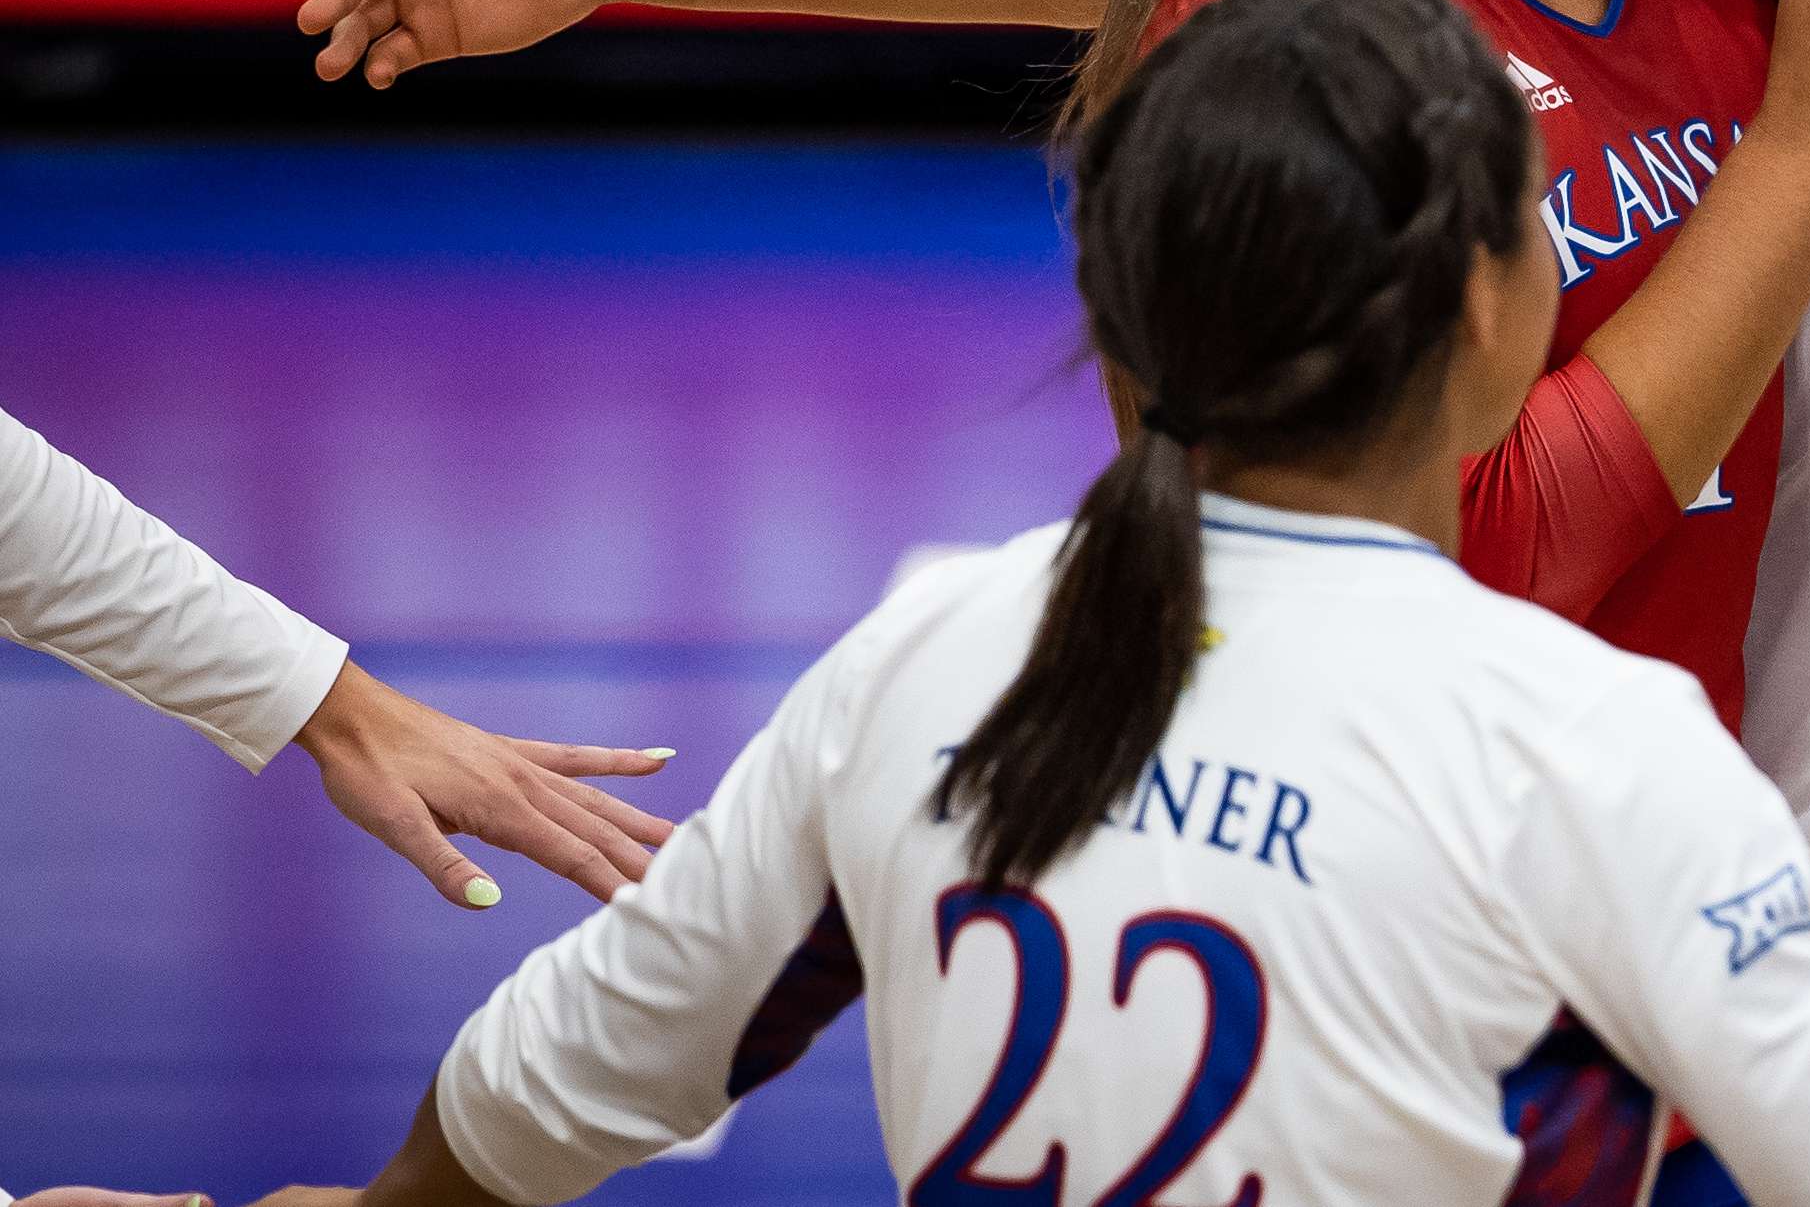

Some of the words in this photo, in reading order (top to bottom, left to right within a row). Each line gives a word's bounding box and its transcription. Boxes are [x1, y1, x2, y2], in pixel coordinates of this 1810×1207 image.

[1537, 117, 1746, 293] KANS
[930, 744, 1314, 886] TNER
[905, 881, 1268, 1207] 22
